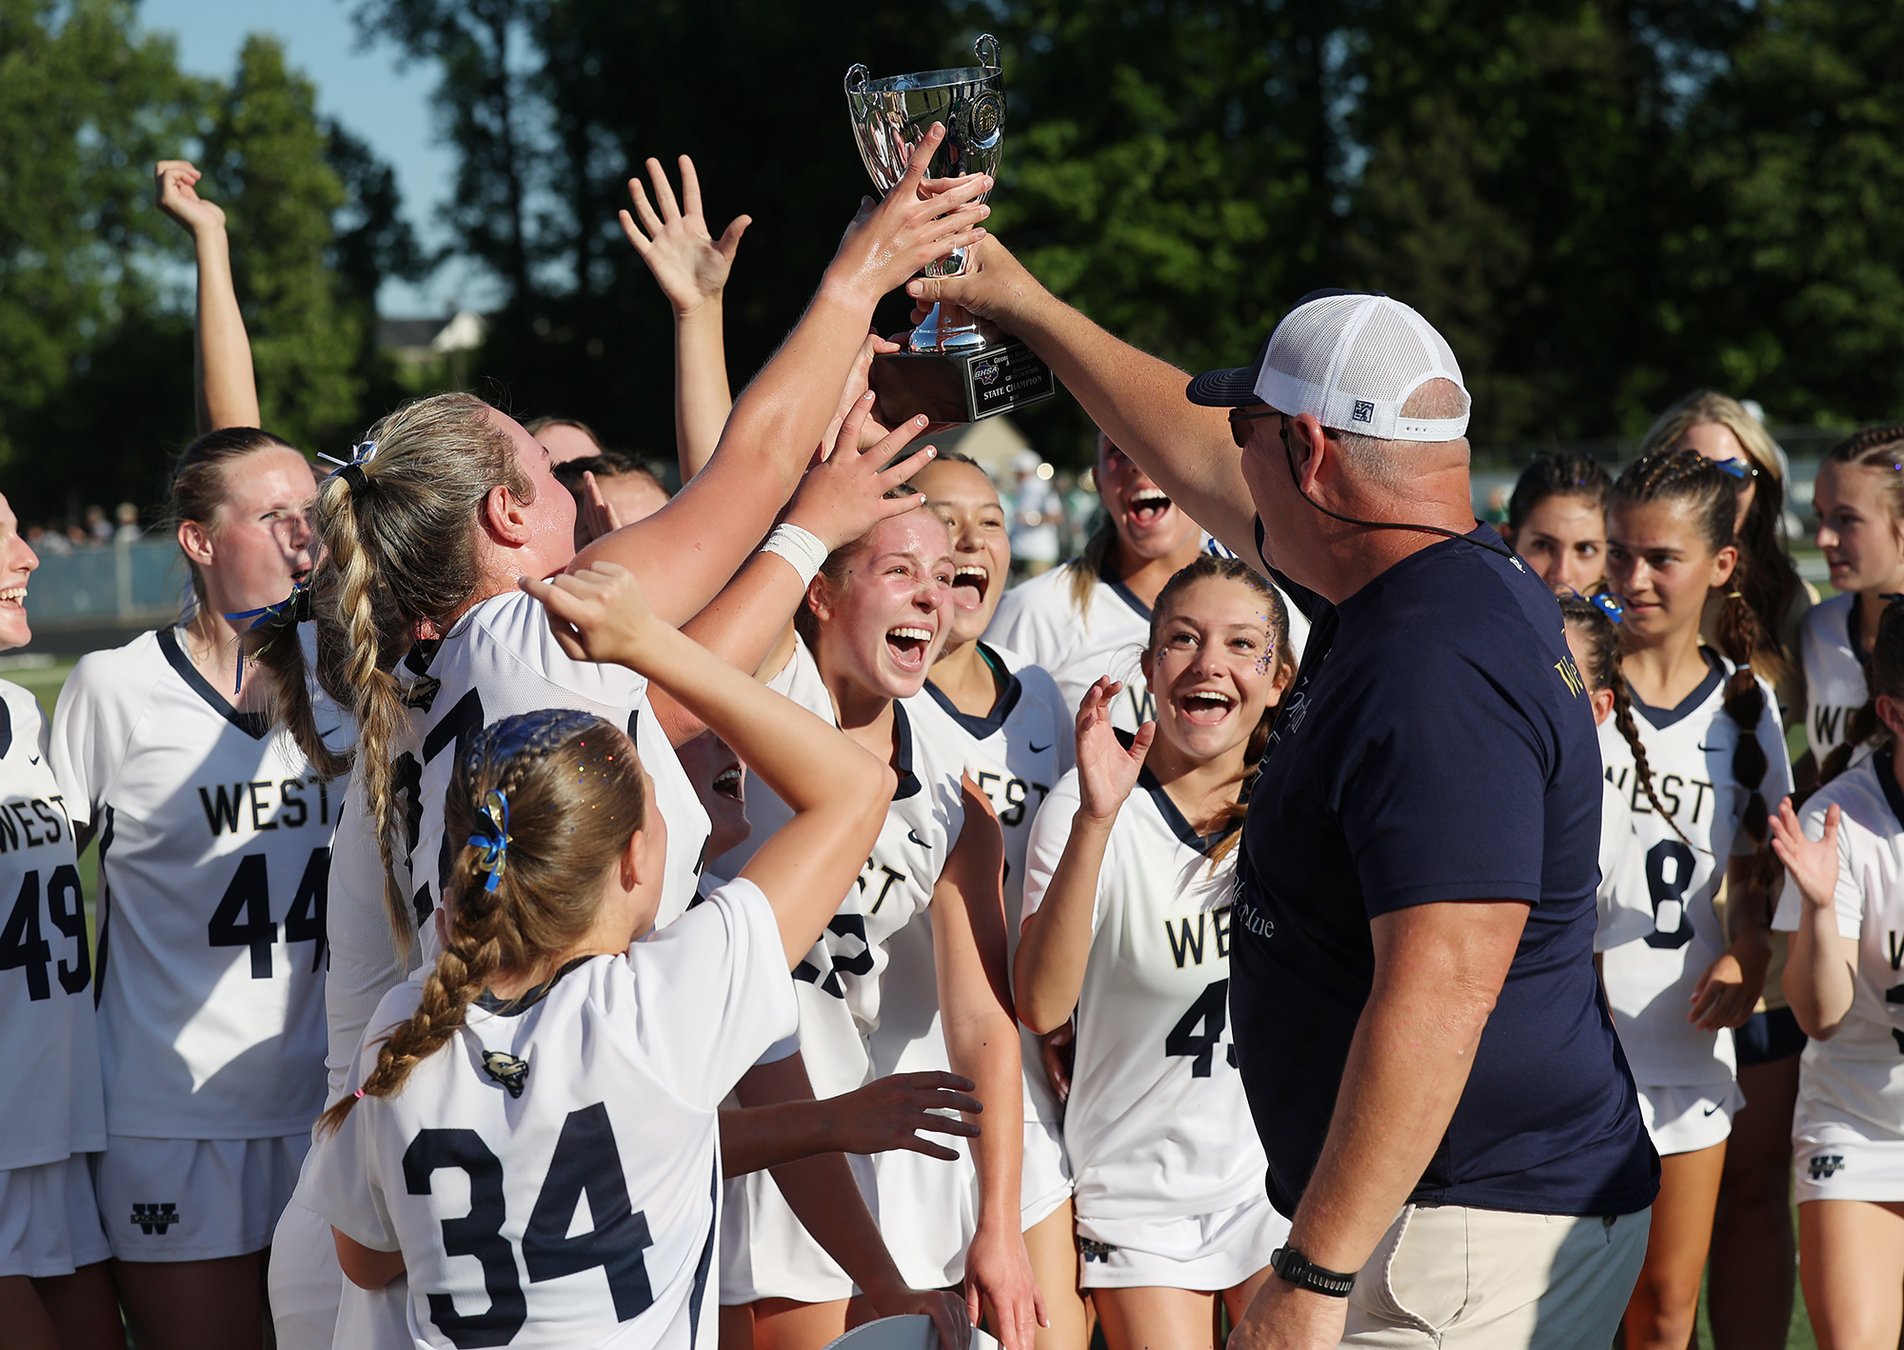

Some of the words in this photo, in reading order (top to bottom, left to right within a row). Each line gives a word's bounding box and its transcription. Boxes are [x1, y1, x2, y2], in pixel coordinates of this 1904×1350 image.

[975, 365, 998, 378] GHSA
[983, 387, 1005, 400] STATE
[1005, 375, 1043, 393] CHAMPION
[197, 776, 332, 836] WEST
[0, 864, 92, 1002] 49
[208, 847, 331, 979] 44
[1644, 838, 1697, 949] 8
[1165, 977, 1239, 1079] 4
[402, 1101, 654, 1350] 34
